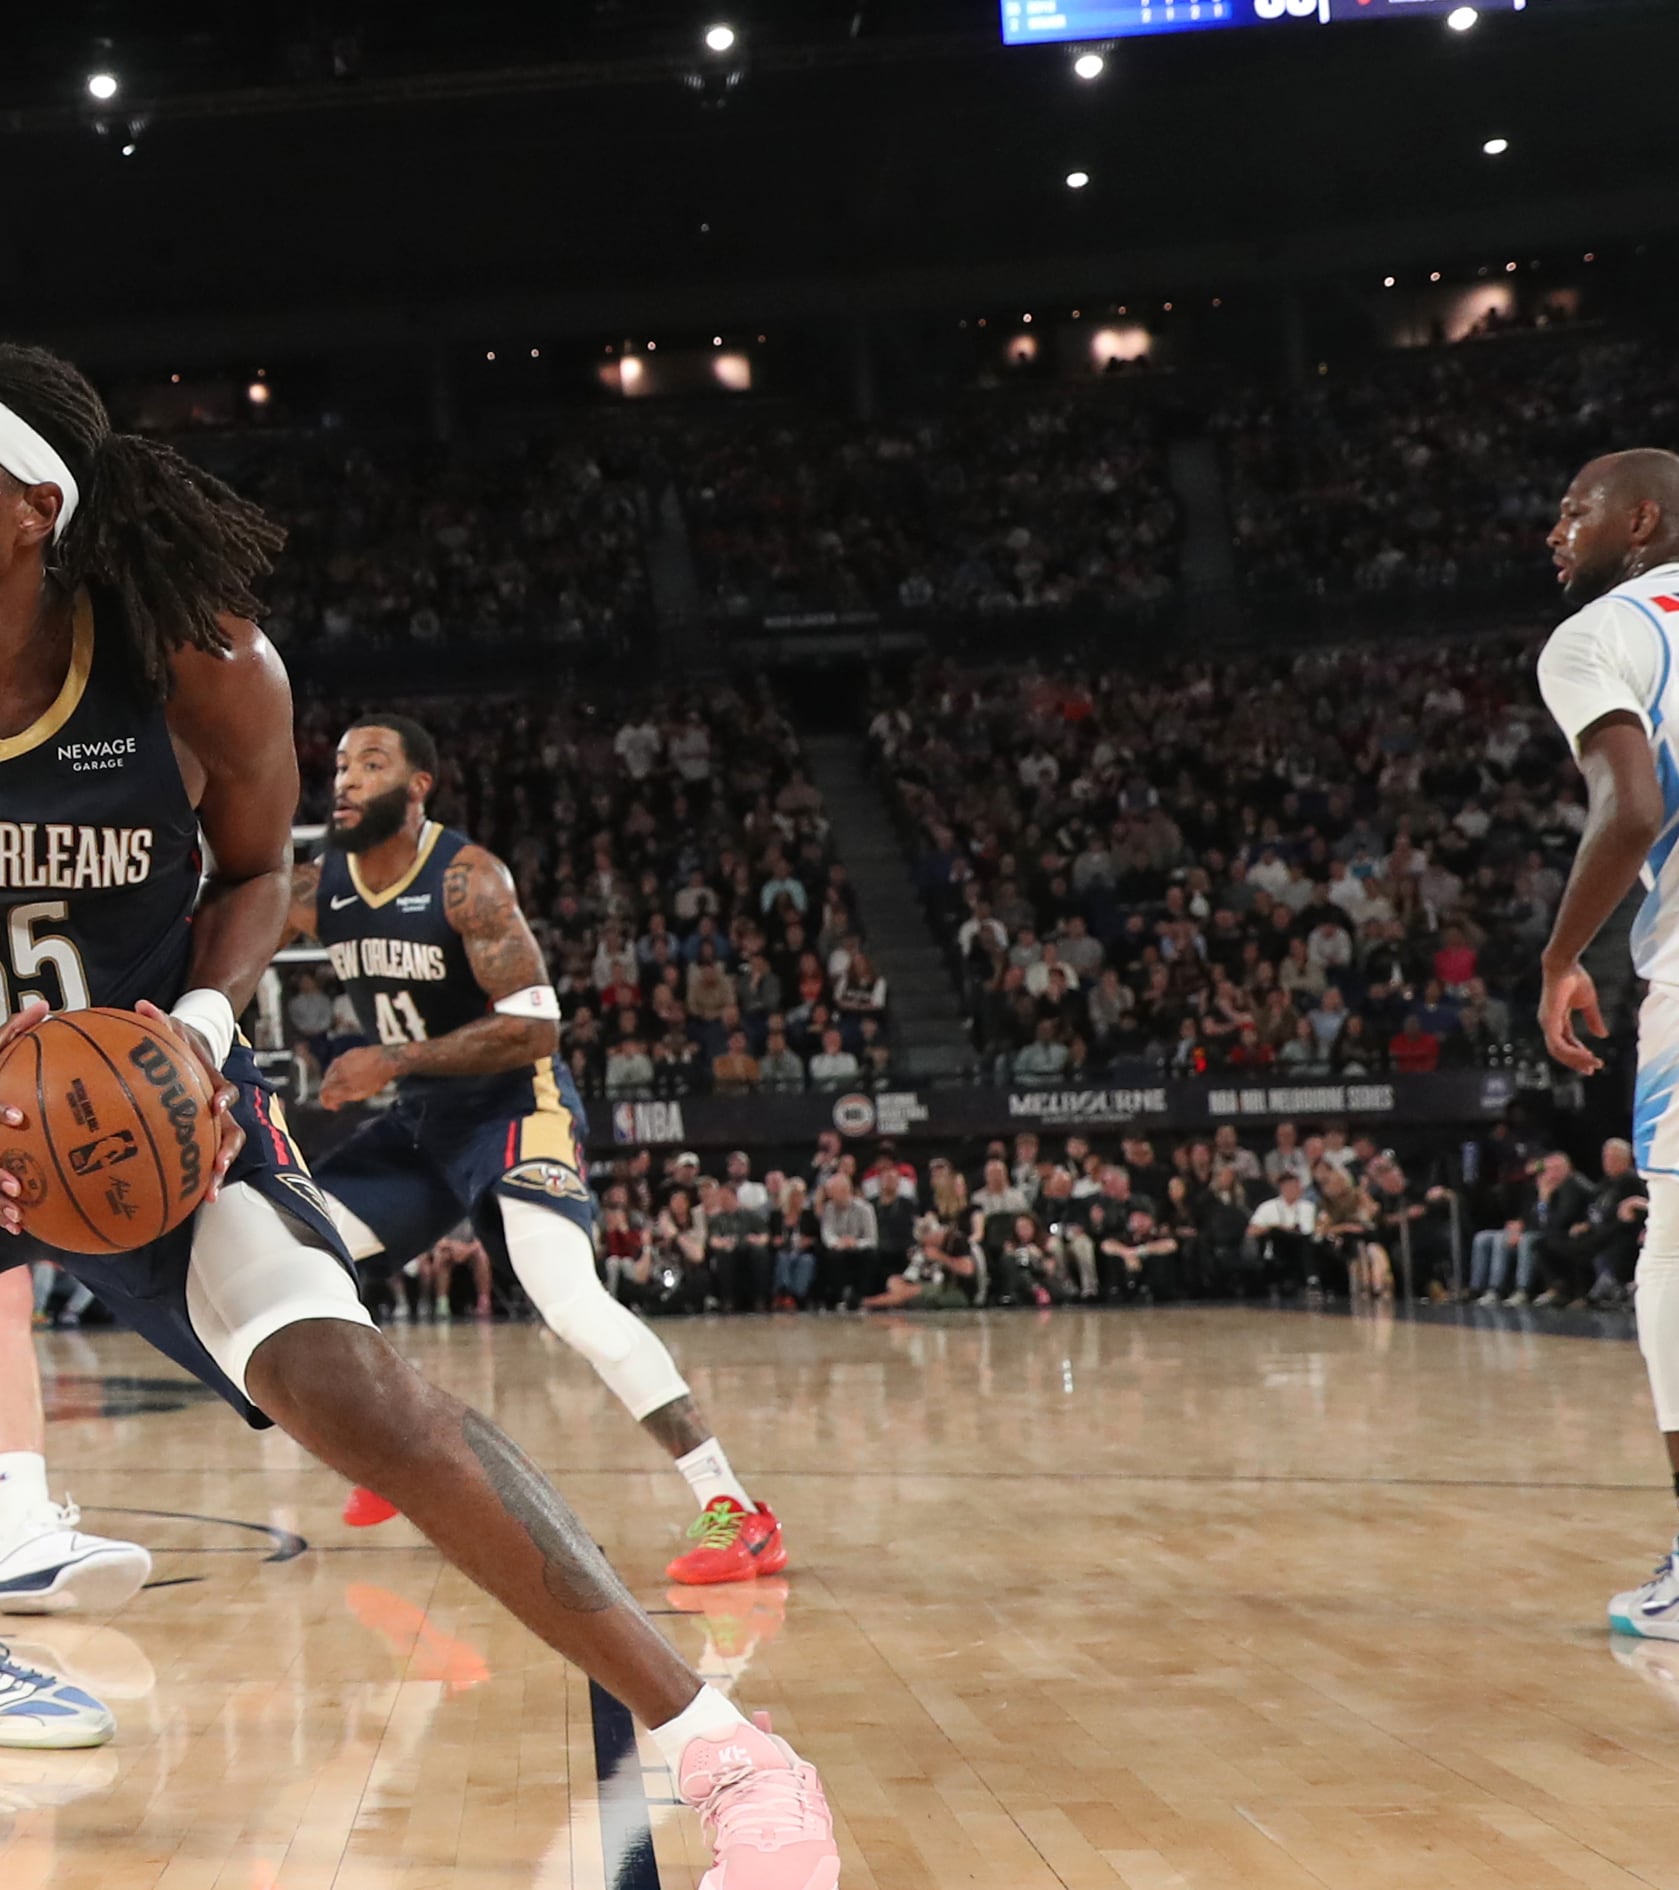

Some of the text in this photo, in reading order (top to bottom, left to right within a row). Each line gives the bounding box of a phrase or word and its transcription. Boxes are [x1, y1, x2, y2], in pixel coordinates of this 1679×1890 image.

[57, 737, 136, 761] NEWAGE
[73, 758, 124, 772] GARAGE
[360, 937, 447, 982] ORLEANS
[374, 990, 428, 1046] 41
[634, 1101, 685, 1143] NBA
